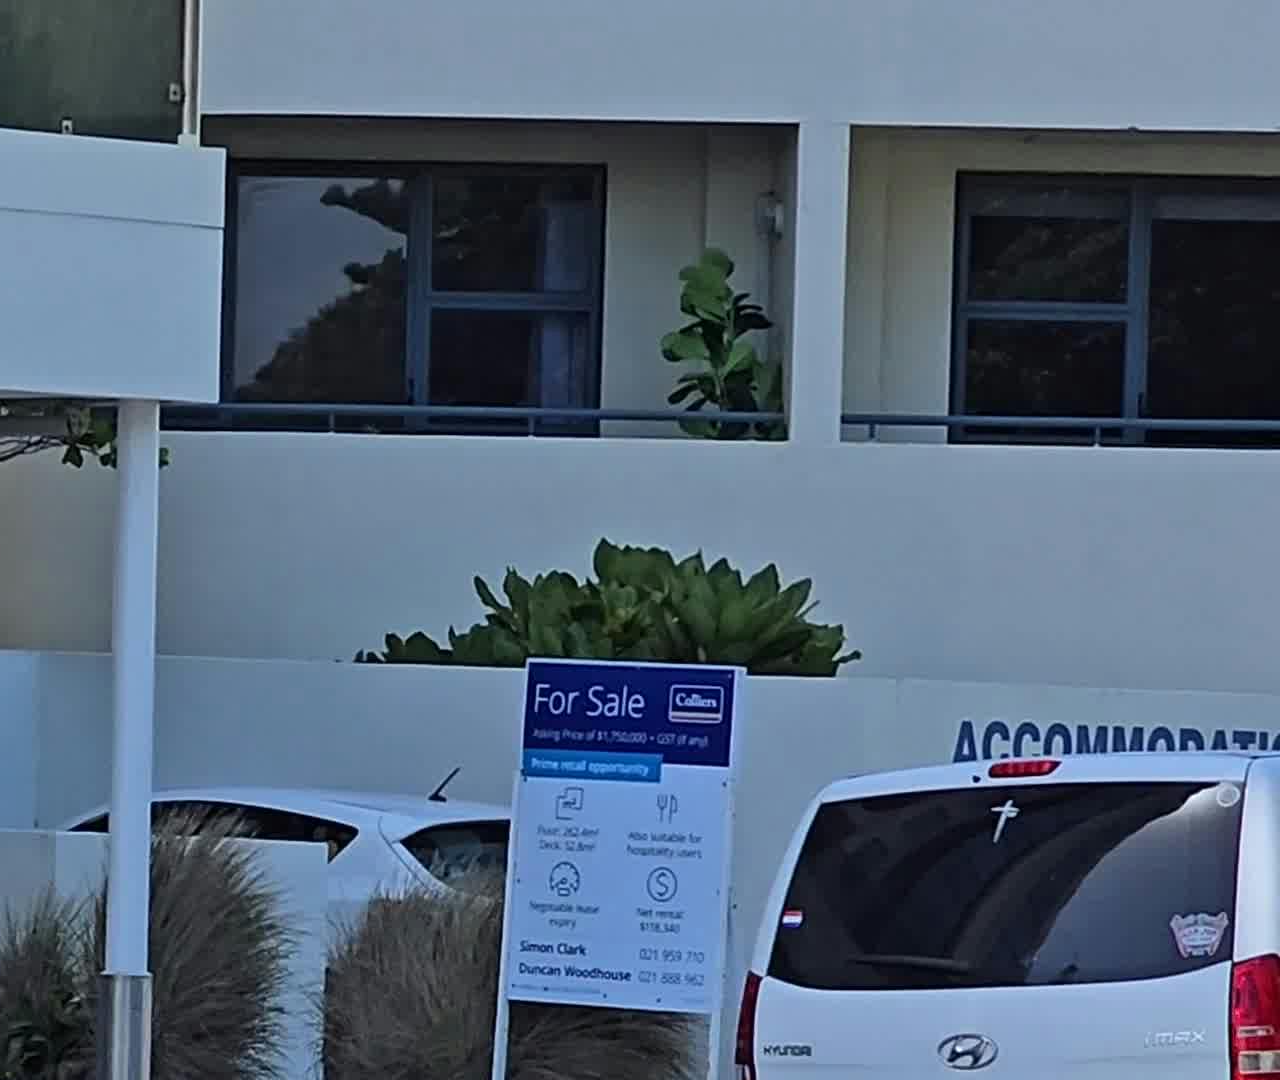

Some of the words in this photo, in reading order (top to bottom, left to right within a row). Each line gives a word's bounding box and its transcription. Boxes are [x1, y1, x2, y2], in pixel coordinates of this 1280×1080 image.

[534, 683, 580, 715] For
[586, 685, 645, 718] Sale
[675, 692, 717, 708] Colliers
[562, 729, 583, 741] Price
[584, 729, 594, 741] of
[656, 734, 675, 745] GST
[531, 757, 558, 770] Prime
[560, 759, 586, 772] retail
[588, 762, 649, 776] opportunity
[519, 940, 554, 954] Simon
[557, 942, 587, 956] Clark
[639, 948, 658, 961] 021
[662, 949, 682, 962] 959
[687, 951, 705, 963] 710
[519, 962, 561, 977] Duncan
[564, 965, 632, 981] Woodhouse
[638, 970, 656, 983] 021
[763, 1045, 812, 1057] HYUNDAI
